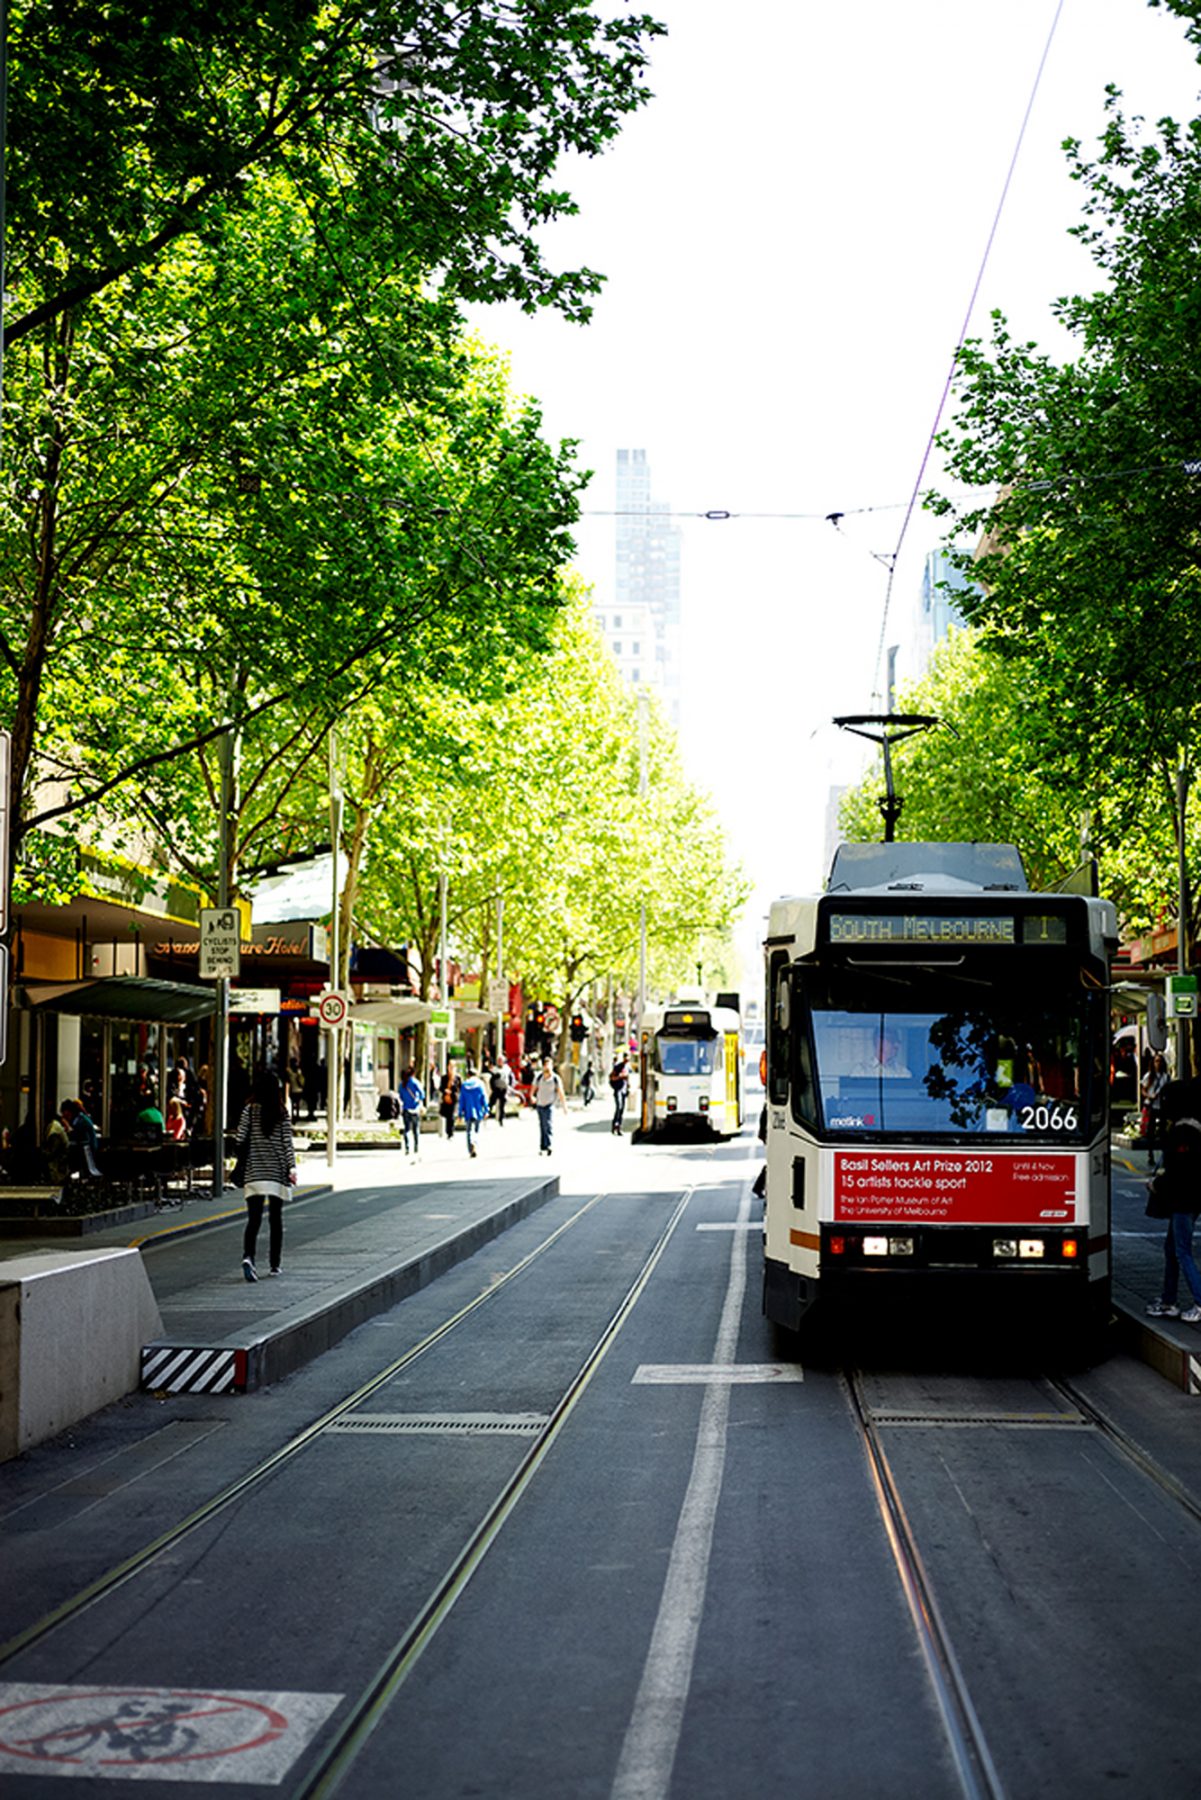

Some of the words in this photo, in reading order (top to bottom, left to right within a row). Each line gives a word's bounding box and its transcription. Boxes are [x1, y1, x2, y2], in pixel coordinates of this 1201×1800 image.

[830, 914, 892, 938] SOUTH
[903, 915, 1014, 940] MELBOURNE
[203, 937, 237, 946] CYCLISTS
[263, 937, 307, 954] Hotel
[211, 947, 229, 955] STOP
[207, 956, 233, 964] BEHIND
[325, 1002, 341, 1017] 30
[1021, 1106, 1077, 1130] 2066
[841, 1159, 868, 1171] Basil
[871, 1159, 910, 1172] Sellers
[913, 1160, 931, 1172] Art
[934, 1160, 962, 1173] Prize
[965, 1160, 993, 1173] 2012
[1039, 1162, 1055, 1171] Nov
[841, 1175, 854, 1188] 15
[857, 1176, 892, 1189] artists
[894, 1176, 933, 1189] tackle
[935, 1177, 967, 1191] sport
[1013, 1173, 1030, 1181] Free
[1032, 1173, 1069, 1182] admission
[841, 1195, 854, 1204] The
[871, 1195, 894, 1205] Potter
[896, 1196, 929, 1205] Museum
[931, 1196, 940, 1205] of
[941, 1196, 953, 1205] Art
[841, 1206, 854, 1215] The
[857, 1206, 892, 1217] University
[893, 1206, 903, 1216] of
[904, 1207, 947, 1217] Melbourne
